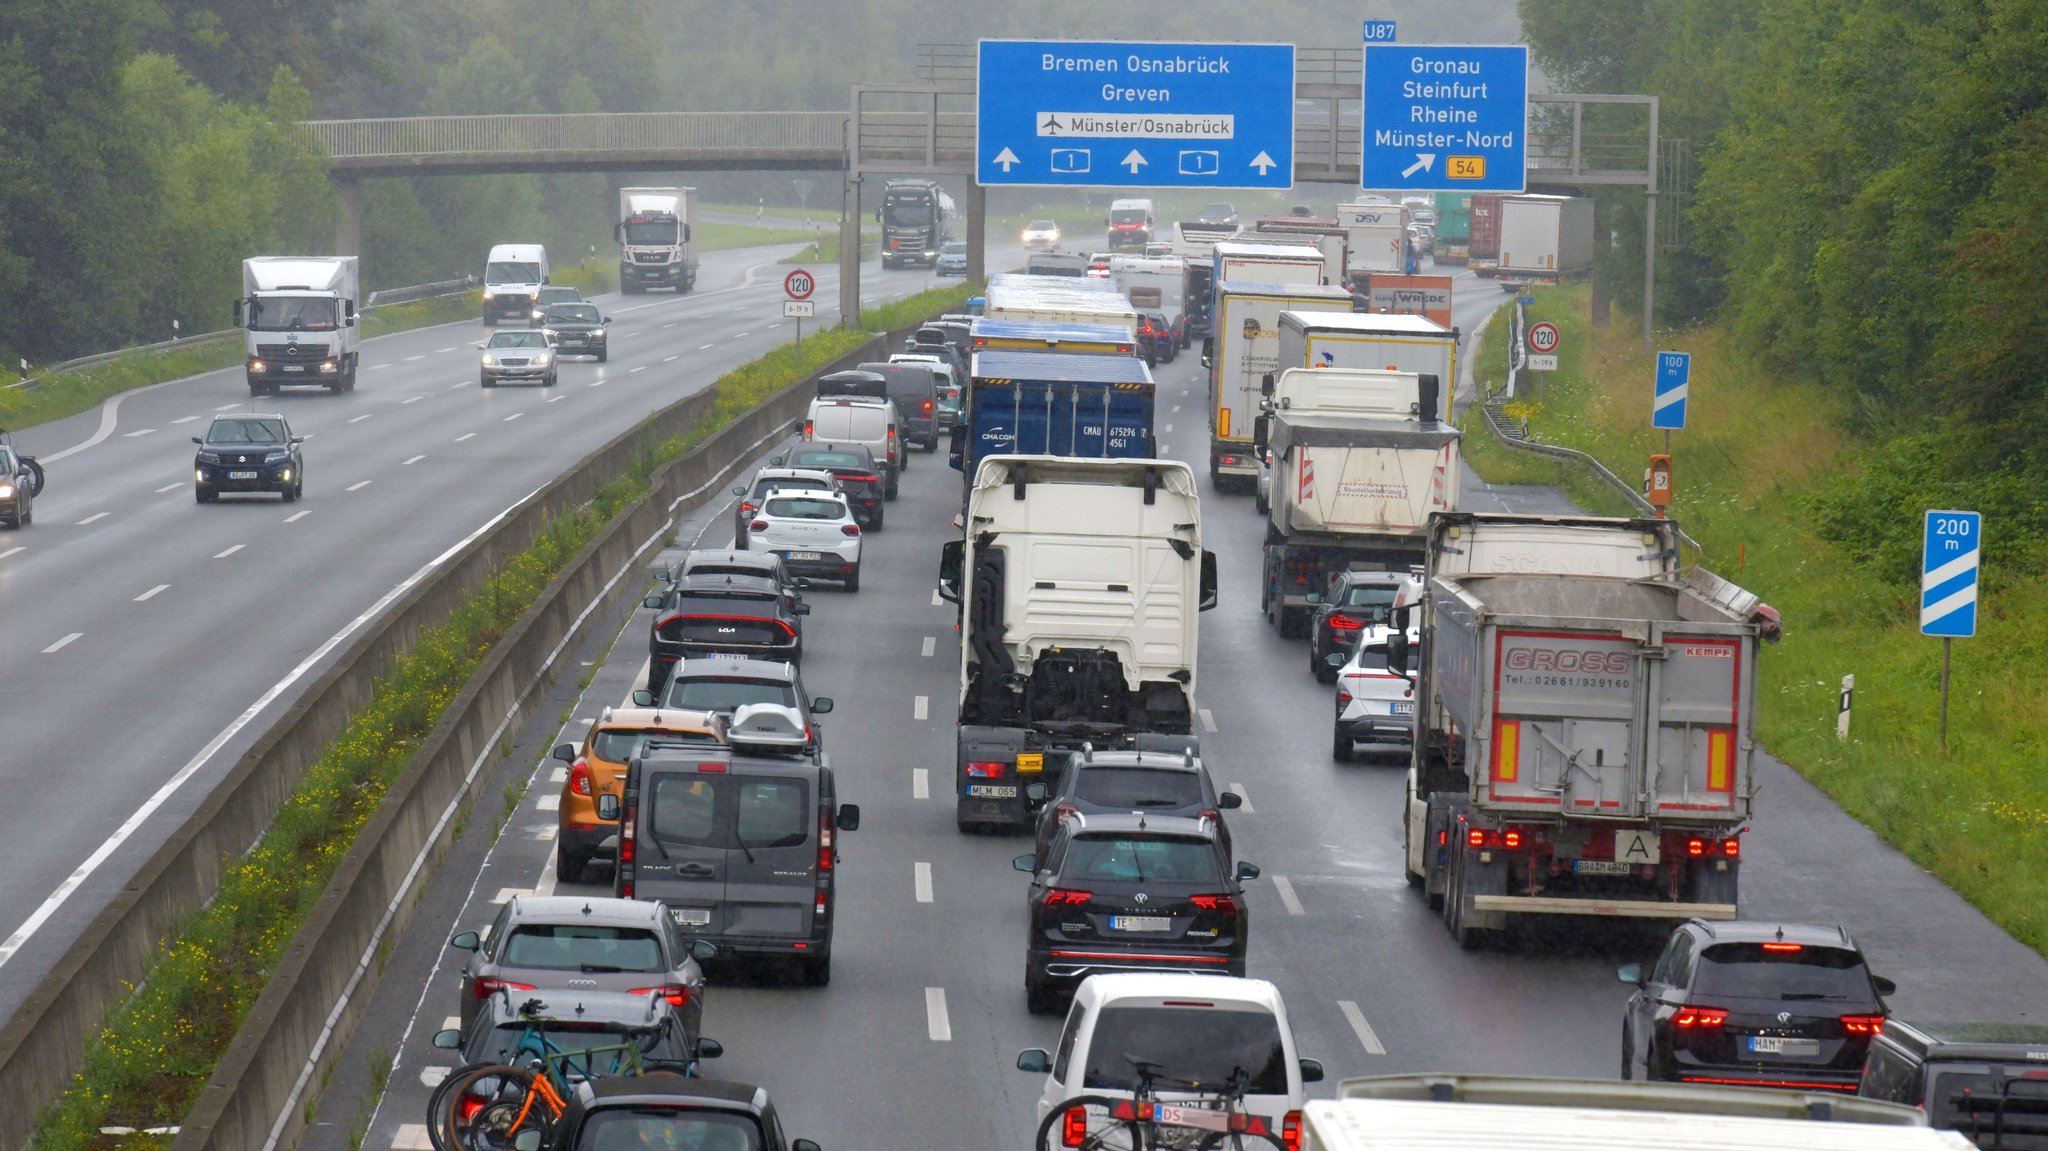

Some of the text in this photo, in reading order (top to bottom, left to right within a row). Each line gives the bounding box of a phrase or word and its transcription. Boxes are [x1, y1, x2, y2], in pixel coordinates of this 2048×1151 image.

[1364, 24, 1395, 39] U87
[1042, 54, 1230, 74] Bremen Osnabrück
[1411, 56, 1480, 74] Gronau
[1102, 84, 1170, 102] Greven
[1403, 80, 1488, 99] Steinfurt
[1411, 106, 1477, 123] Rheine
[1071, 117, 1230, 134] Münster/Osnabrück
[1375, 129, 1513, 148] Münster-Nord
[1068, 153, 1075, 169] 1
[1196, 155, 1202, 170] 1
[1456, 160, 1475, 175] 54
[1355, 214, 1381, 223] DSV
[790, 277, 809, 292] 120
[1399, 294, 1445, 303] WREDE
[1535, 331, 1554, 345] 120
[1665, 356, 1683, 368] 100
[1668, 369, 1677, 377] m
[1083, 426, 1101, 436] CMAU
[1109, 427, 1136, 437] 675296
[1109, 438, 1127, 448] 45G1
[1936, 518, 1970, 536] 200
[1945, 539, 1959, 550] m
[1686, 648, 1731, 657] KEMPF
[1505, 647, 1631, 675] GROSS
[972, 786, 1015, 797] MLM 065
[1625, 834, 1649, 859] A
[1116, 916, 1128, 928] TE
[1755, 1038, 1776, 1051] HAM
[1163, 1108, 1181, 1121] DS
